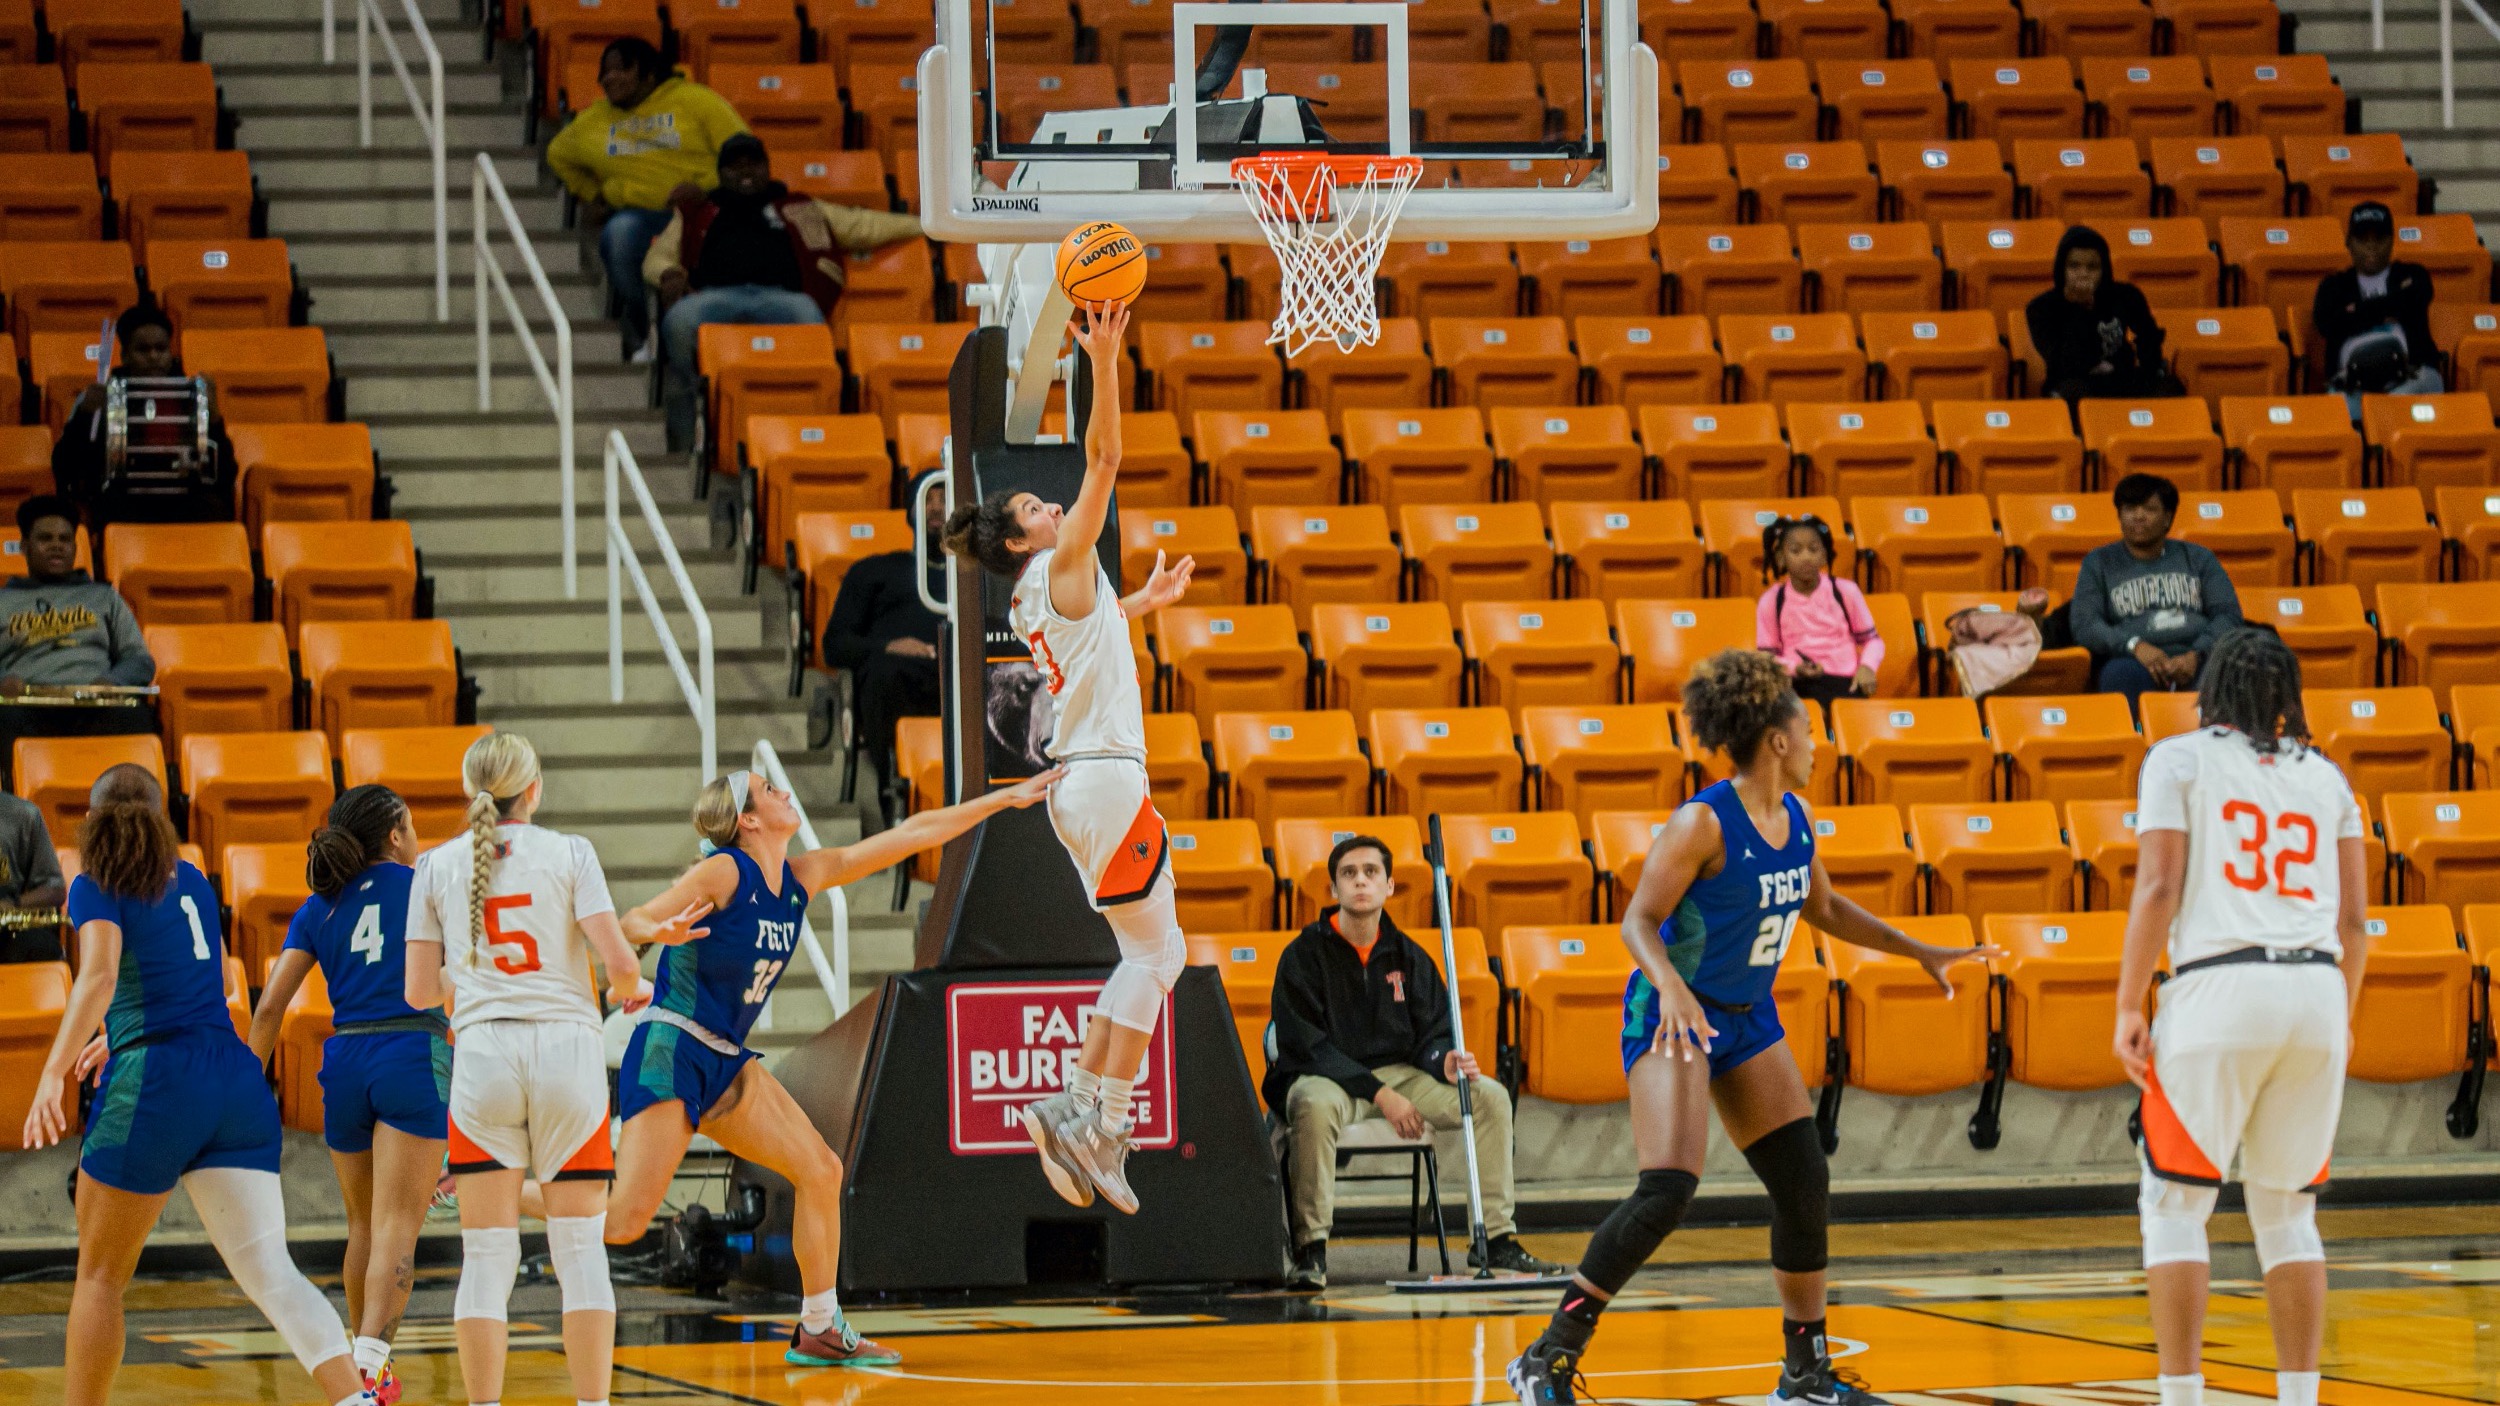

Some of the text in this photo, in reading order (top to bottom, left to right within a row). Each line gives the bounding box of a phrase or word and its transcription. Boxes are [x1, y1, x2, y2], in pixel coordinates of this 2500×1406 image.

[972, 197, 1040, 212] SPALDING
[1072, 222, 1114, 246] NCAA
[1079, 236, 1137, 267] Wilson
[2221, 799, 2318, 902] 32
[1759, 864, 1811, 908] FGCU
[180, 895, 211, 960] 1
[350, 904, 385, 965] 4
[484, 893, 542, 975] 5
[755, 919, 796, 952] FGCU
[1748, 909, 1801, 967] 20
[743, 958, 783, 1005] 32
